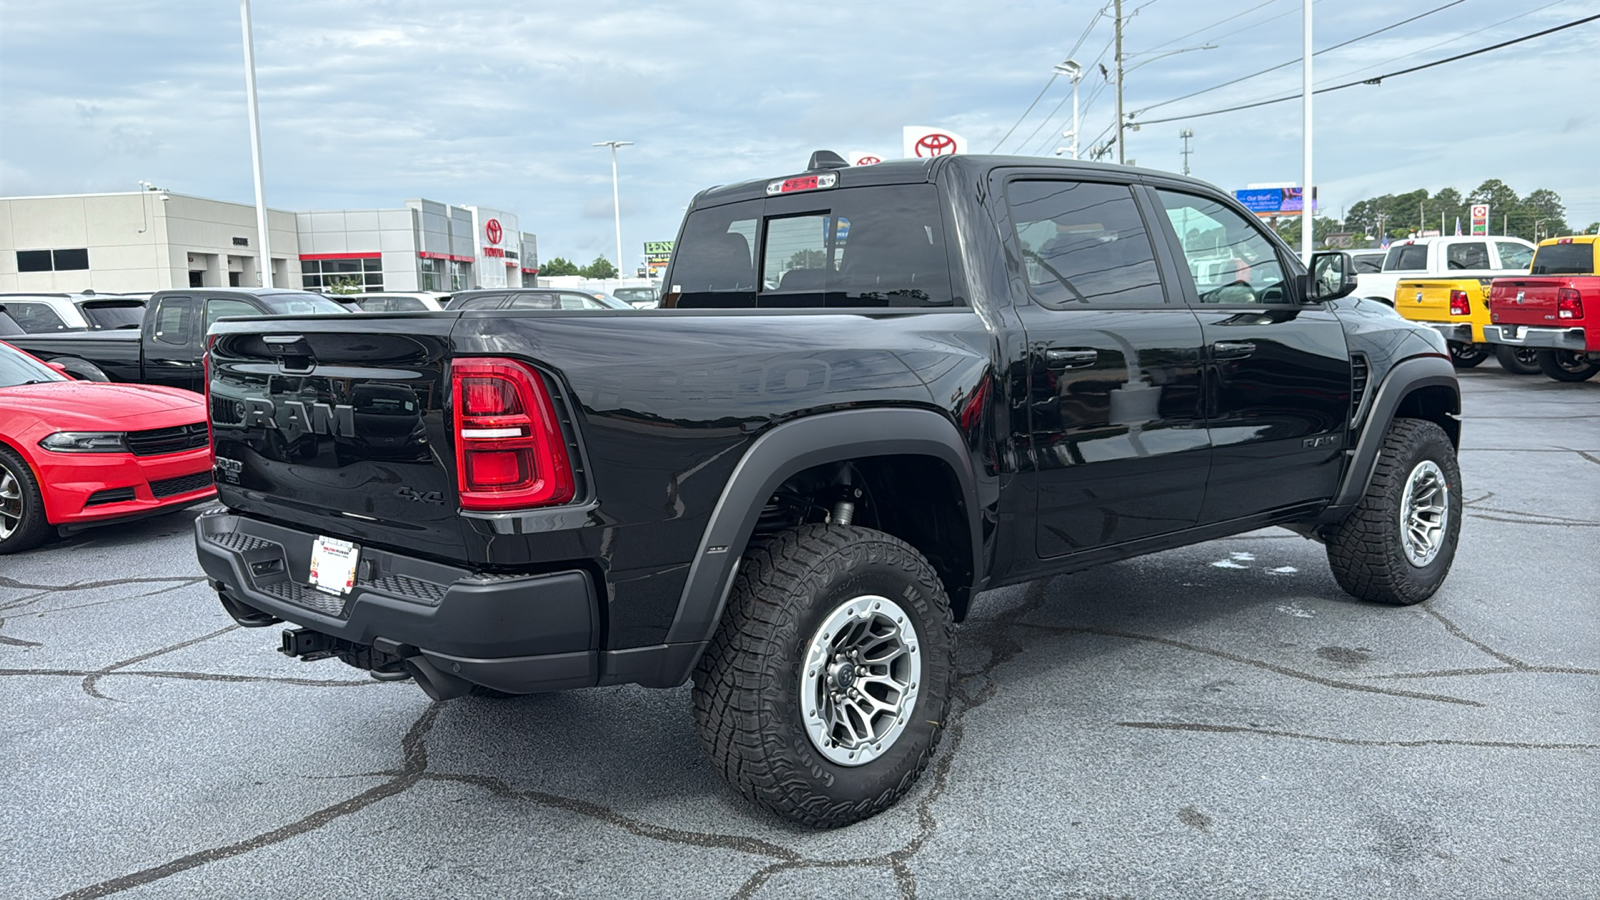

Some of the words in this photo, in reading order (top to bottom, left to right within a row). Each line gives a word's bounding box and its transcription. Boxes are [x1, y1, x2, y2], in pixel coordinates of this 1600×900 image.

[245, 396, 355, 438] RAM
[1302, 435, 1338, 449] RAM
[902, 582, 945, 712] WRANGLER
[787, 637, 835, 788] GOODYEAR
